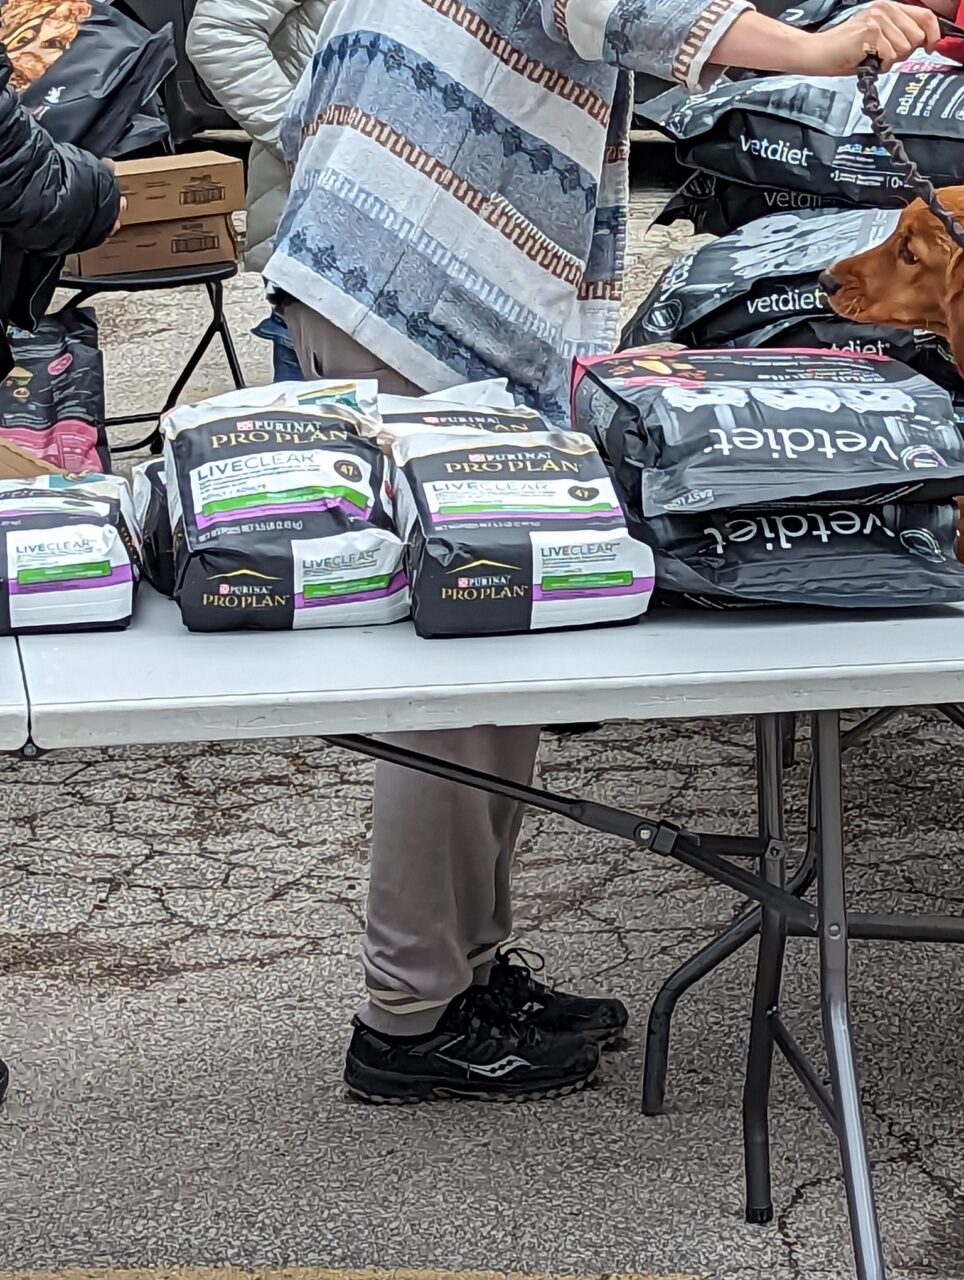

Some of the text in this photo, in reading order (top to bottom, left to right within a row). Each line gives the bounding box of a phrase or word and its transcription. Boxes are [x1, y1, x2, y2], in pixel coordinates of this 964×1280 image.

[740, 134, 813, 167] vetdiet
[747, 288, 827, 315] vetdiet
[254, 421, 316, 433] PURINA
[211, 429, 348, 449] PRO PLAN
[708, 427, 899, 461] vetdiet
[486, 452, 547, 462] PURINA
[198, 452, 315, 482] LIVECLEAR
[444, 459, 581, 474] PRO PLAN
[703, 511, 897, 555] vetdiet
[16, 538, 91, 554] LIVECLEAR
[541, 544, 615, 558] LIVECLEAR
[302, 550, 376, 569] LIVECLEAR
[229, 585, 269, 595] PURINA
[467, 576, 508, 588] PURINA
[441, 584, 526, 600] PRO PLAN
[202, 593, 287, 608] PRO PLAN
